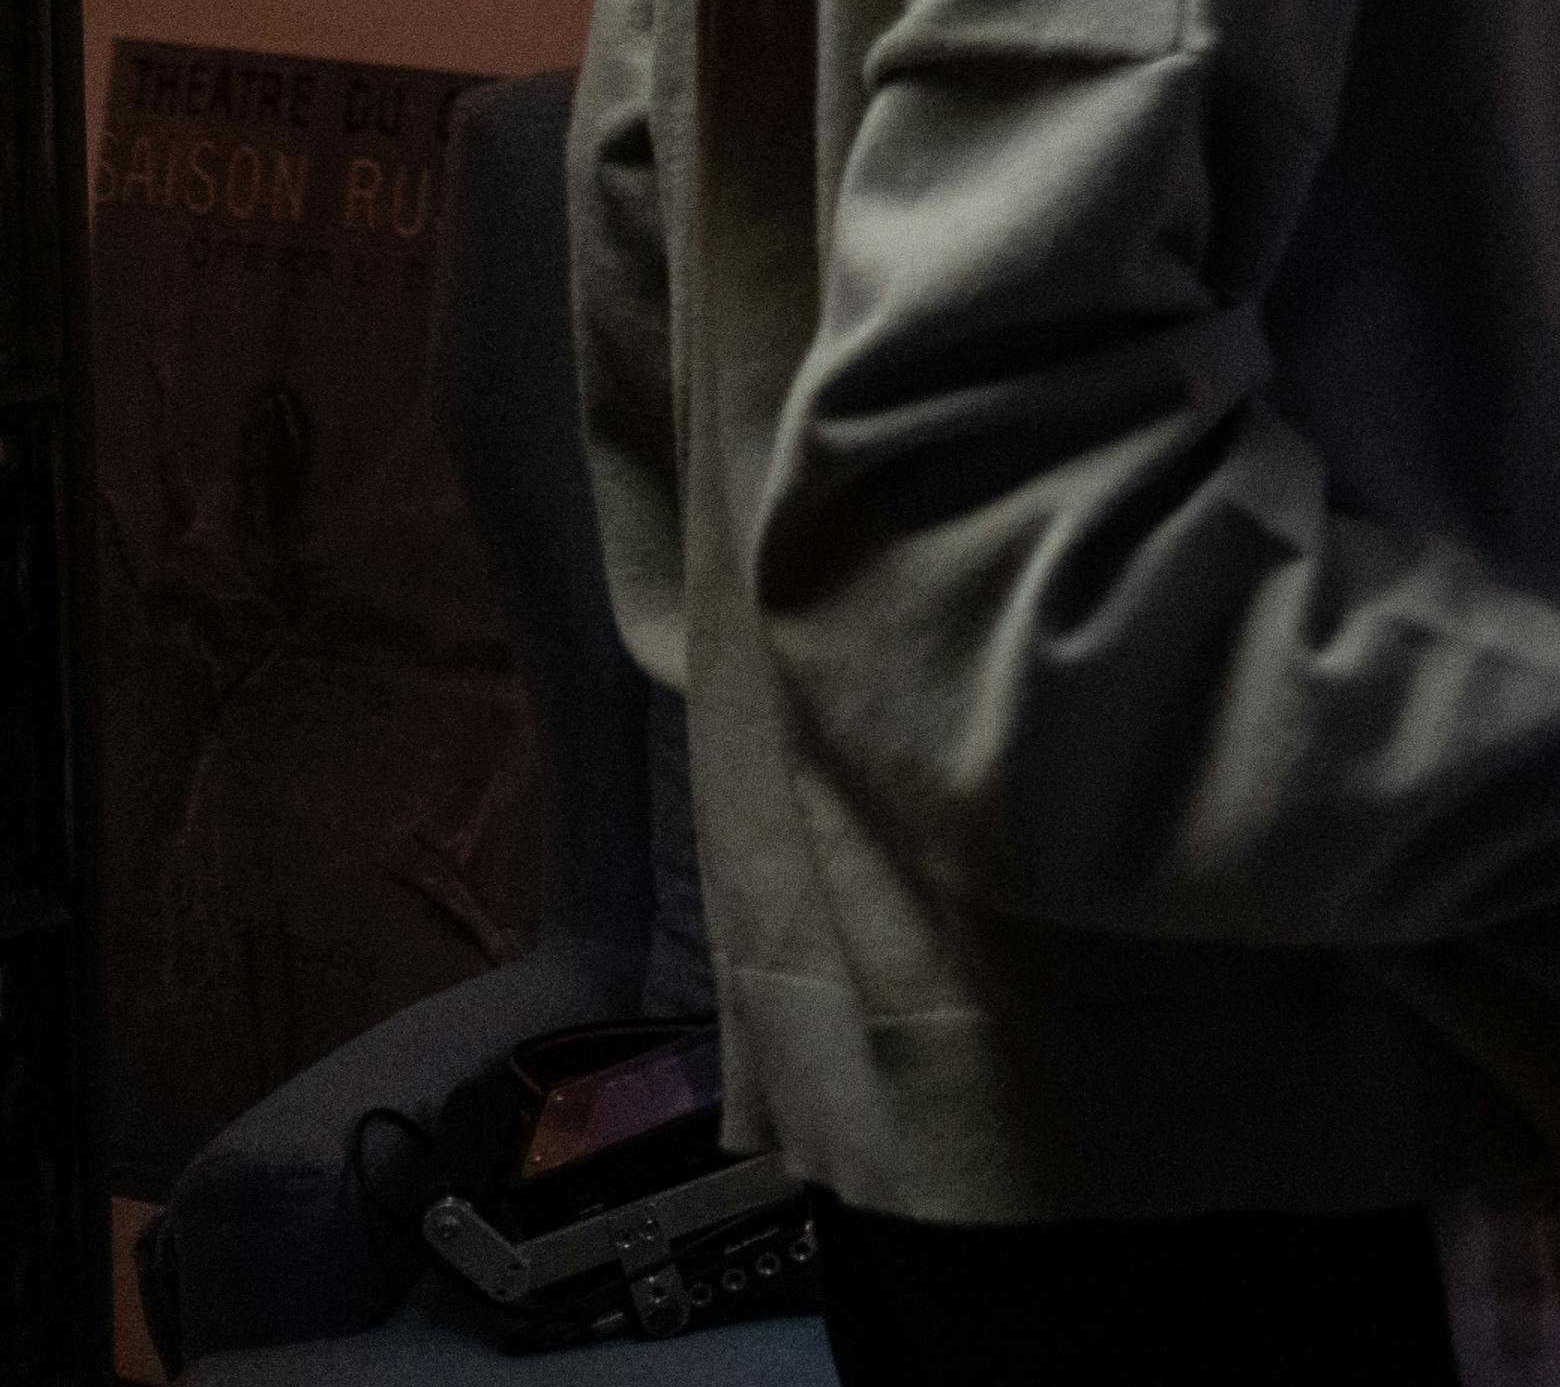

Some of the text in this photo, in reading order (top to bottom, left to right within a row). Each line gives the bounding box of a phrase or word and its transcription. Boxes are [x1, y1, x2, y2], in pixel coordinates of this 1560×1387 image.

[342, 75, 402, 137] DU
[95, 128, 432, 238] SAISON RU
